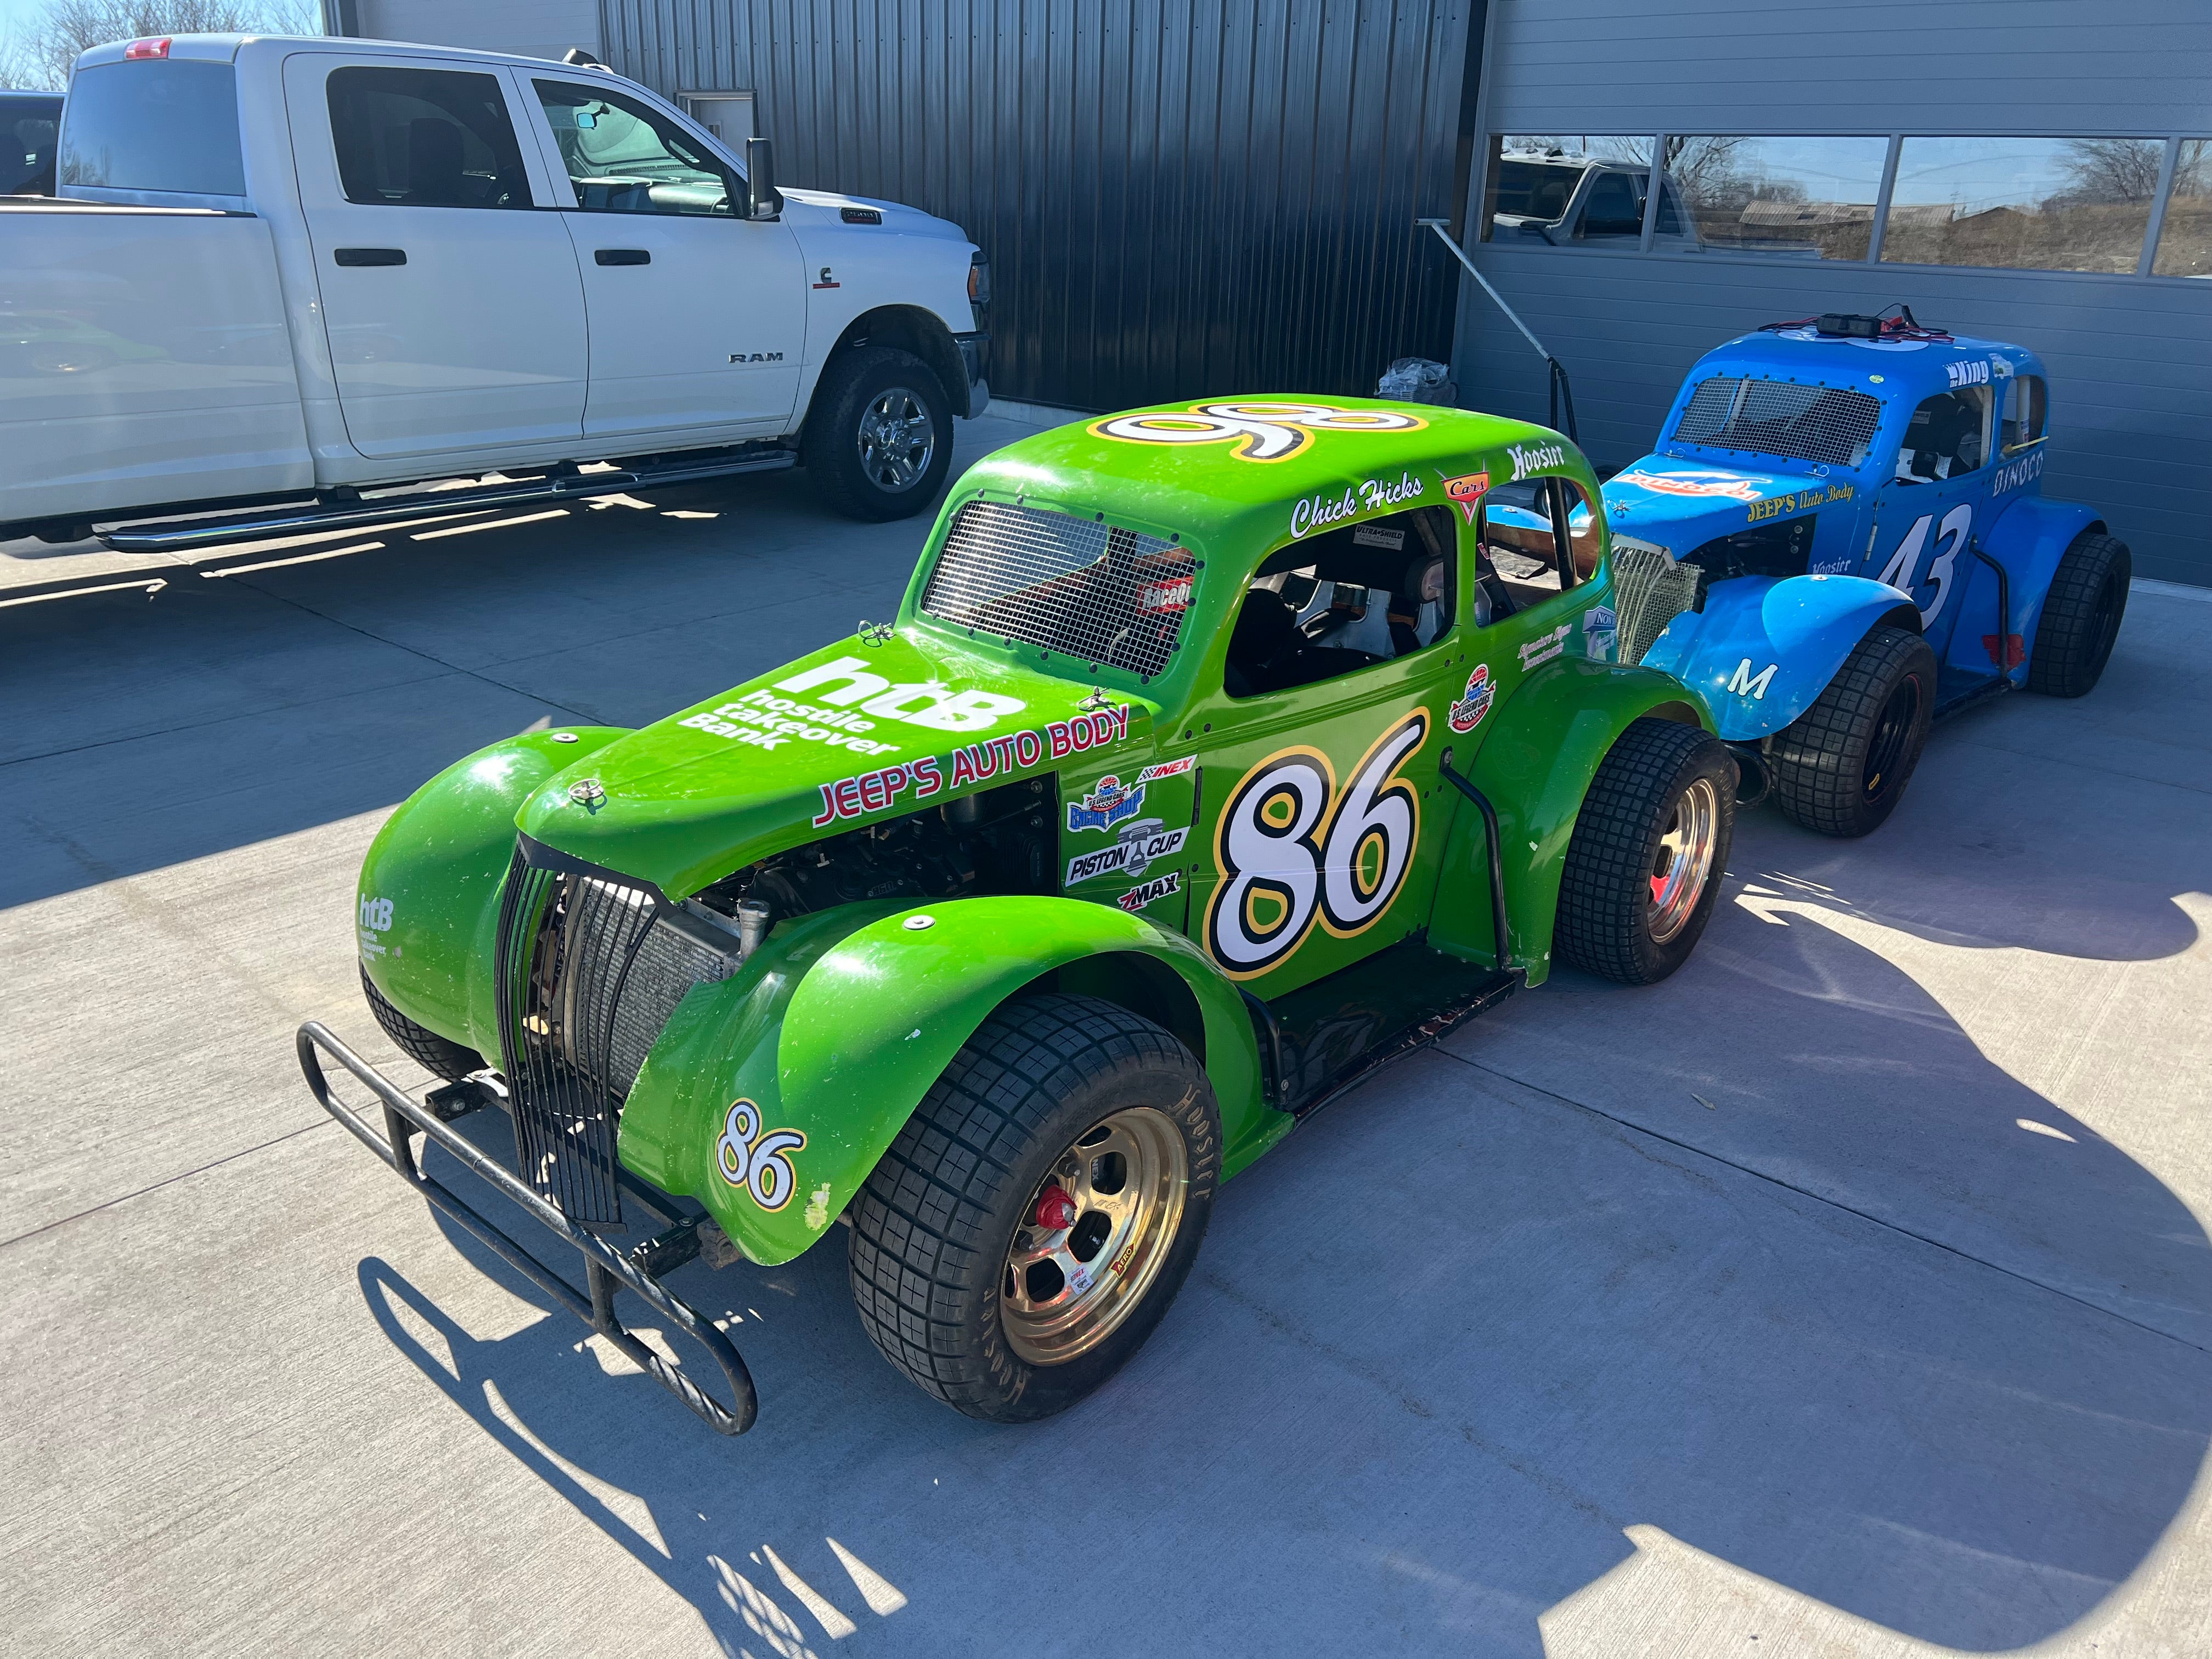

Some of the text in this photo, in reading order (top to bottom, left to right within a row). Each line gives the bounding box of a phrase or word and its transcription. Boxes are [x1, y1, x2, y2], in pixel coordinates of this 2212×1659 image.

[728, 352, 783, 363] RAM
[1954, 360, 1989, 386] King
[1506, 439, 1565, 482] Hoosier
[1993, 450, 2044, 498] DINOCO
[1290, 471, 1424, 539] Chick Hicks
[1449, 481, 1485, 496] Cars
[1628, 477, 1746, 495] DINOCO
[1747, 482, 1854, 523] JEEP'S Auto Body
[1812, 556, 1852, 574] Hoosier
[1877, 504, 1972, 631] 43
[771, 656, 1027, 732] htB
[1727, 657, 1779, 701] M
[676, 713, 792, 751] Bank
[713, 702, 902, 756] takeover
[738, 689, 876, 733] hostile
[811, 704, 1130, 829] JEEP'S AUTO BODY
[1152, 757, 1193, 778] INEX
[1070, 786, 1144, 830] ENGINE SHOP
[1070, 844, 1130, 881] PISTON
[1147, 832, 1182, 857] CUP
[1201, 706, 1431, 981] 86
[359, 891, 394, 932] htB
[715, 1097, 808, 1214] 86
[1117, 1248, 1132, 1272] AERO
